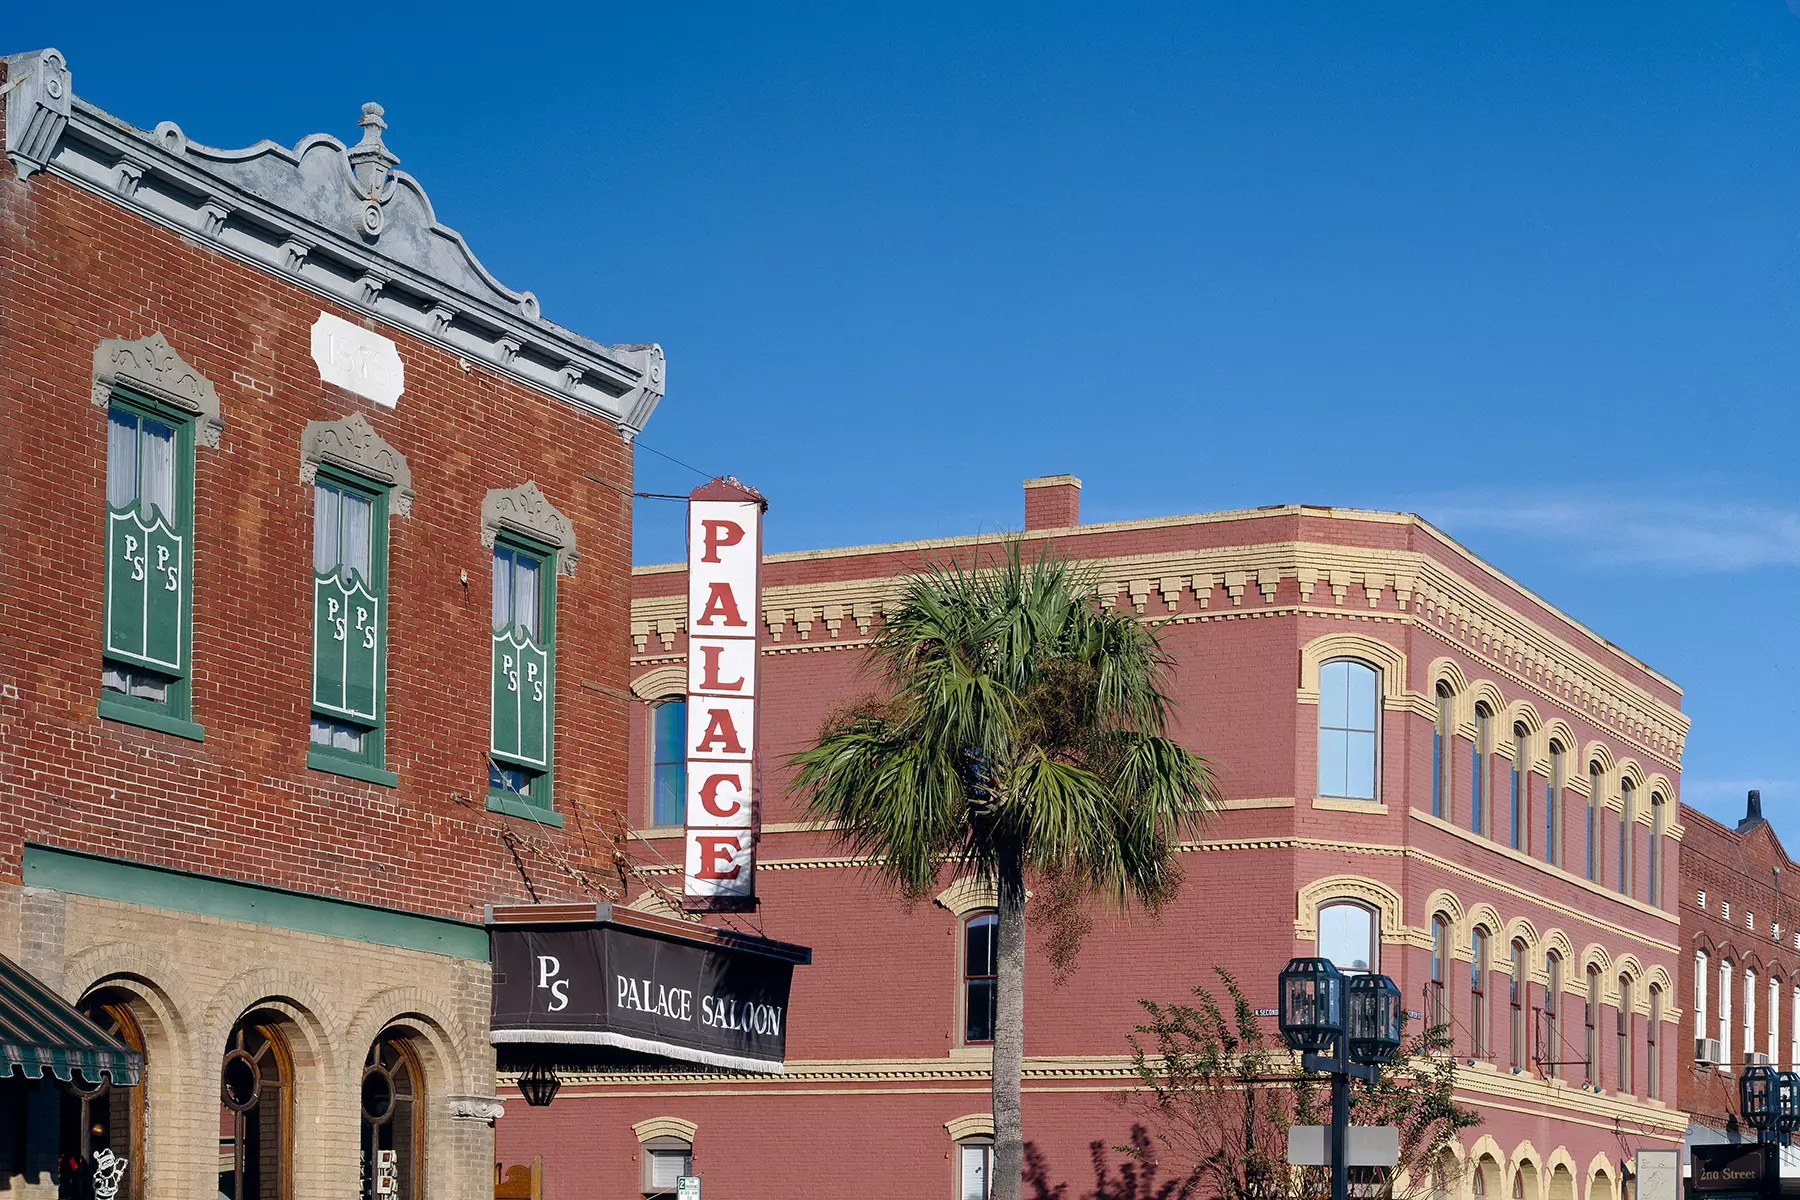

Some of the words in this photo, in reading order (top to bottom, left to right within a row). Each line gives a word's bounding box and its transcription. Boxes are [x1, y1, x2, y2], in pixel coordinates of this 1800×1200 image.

[327, 331, 389, 388] 1878
[695, 519, 747, 880] PALACE
[616, 974, 692, 1022] PALACE
[701, 994, 783, 1037] SALOON
[679, 1179, 685, 1189] 2
[1722, 1167, 1757, 1180] Street
